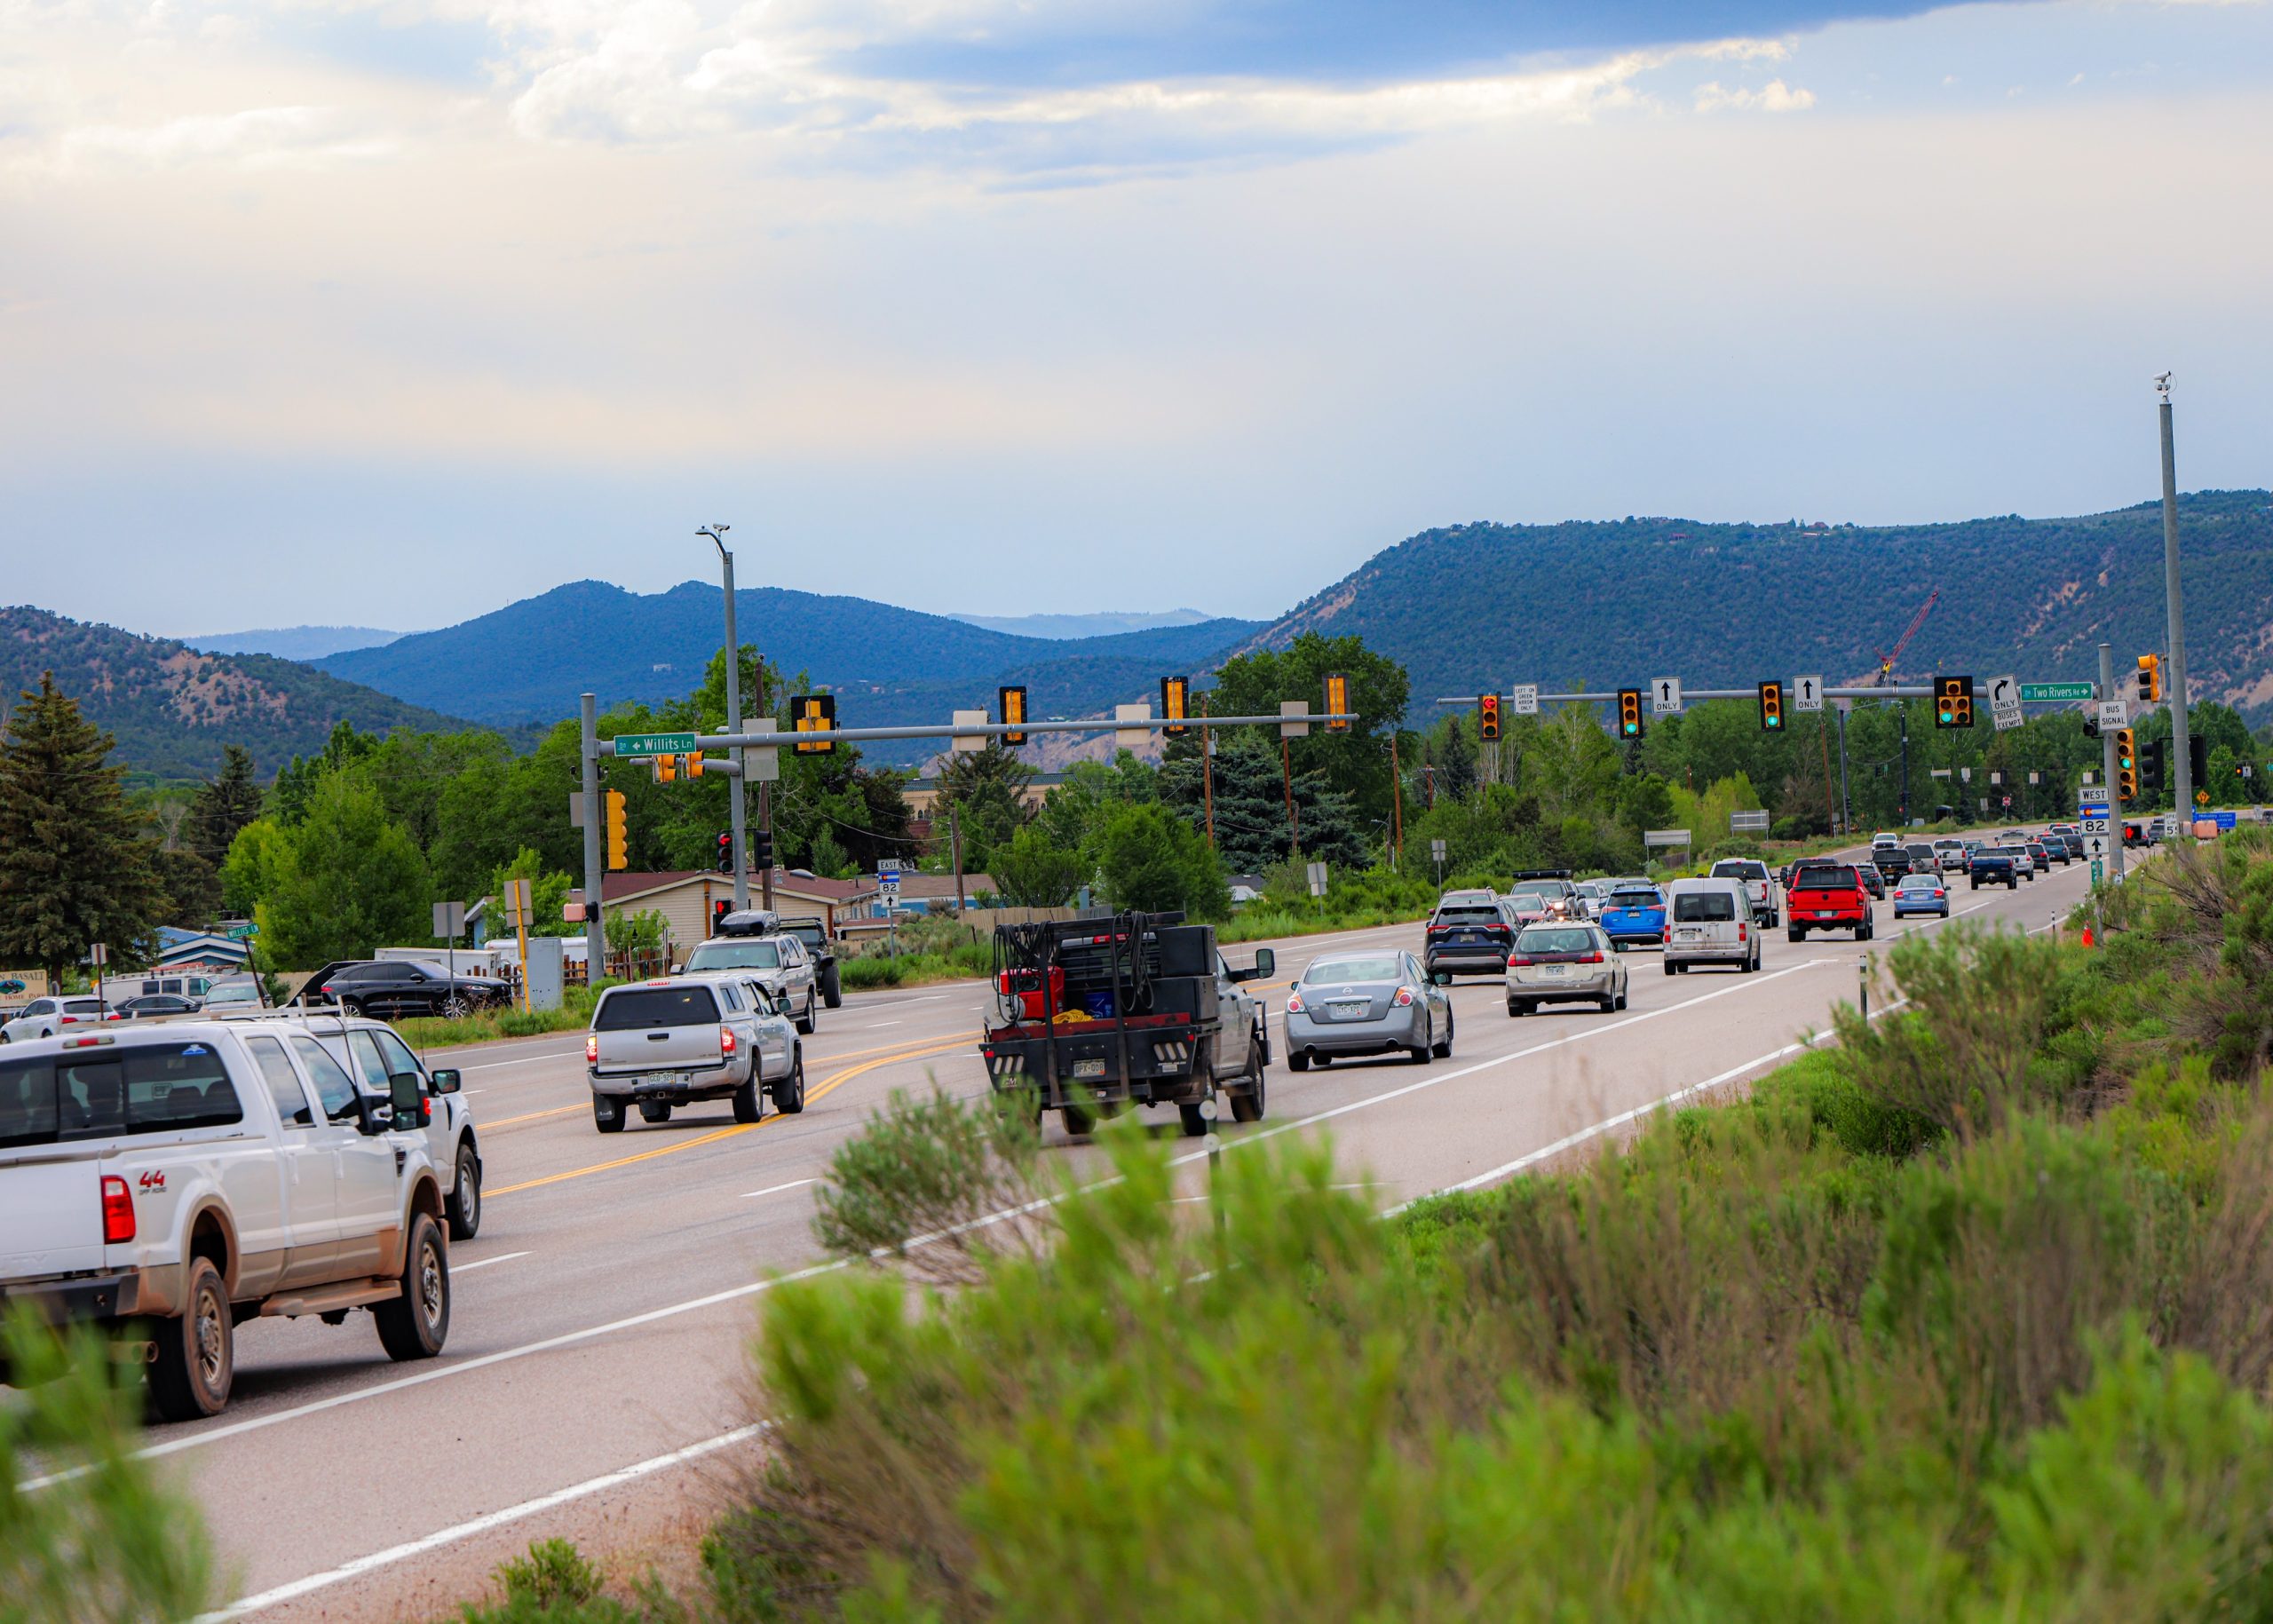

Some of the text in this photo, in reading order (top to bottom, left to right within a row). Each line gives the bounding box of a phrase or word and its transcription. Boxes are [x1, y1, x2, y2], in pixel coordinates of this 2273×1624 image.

[2033, 687, 2047, 698] Two
[2048, 686, 2072, 697] Rivers
[1994, 700, 2016, 709] ONLY
[1998, 710, 2017, 720] BUSES
[1998, 719, 2021, 729] EXEMPT
[644, 738, 693, 751] Willits Ln
[2082, 790, 2106, 799] WEST
[2086, 820, 2105, 832] 82
[883, 883, 897, 892] 82
[227, 924, 259, 938] WILLITS LN
[12, 971, 44, 981] BASALT
